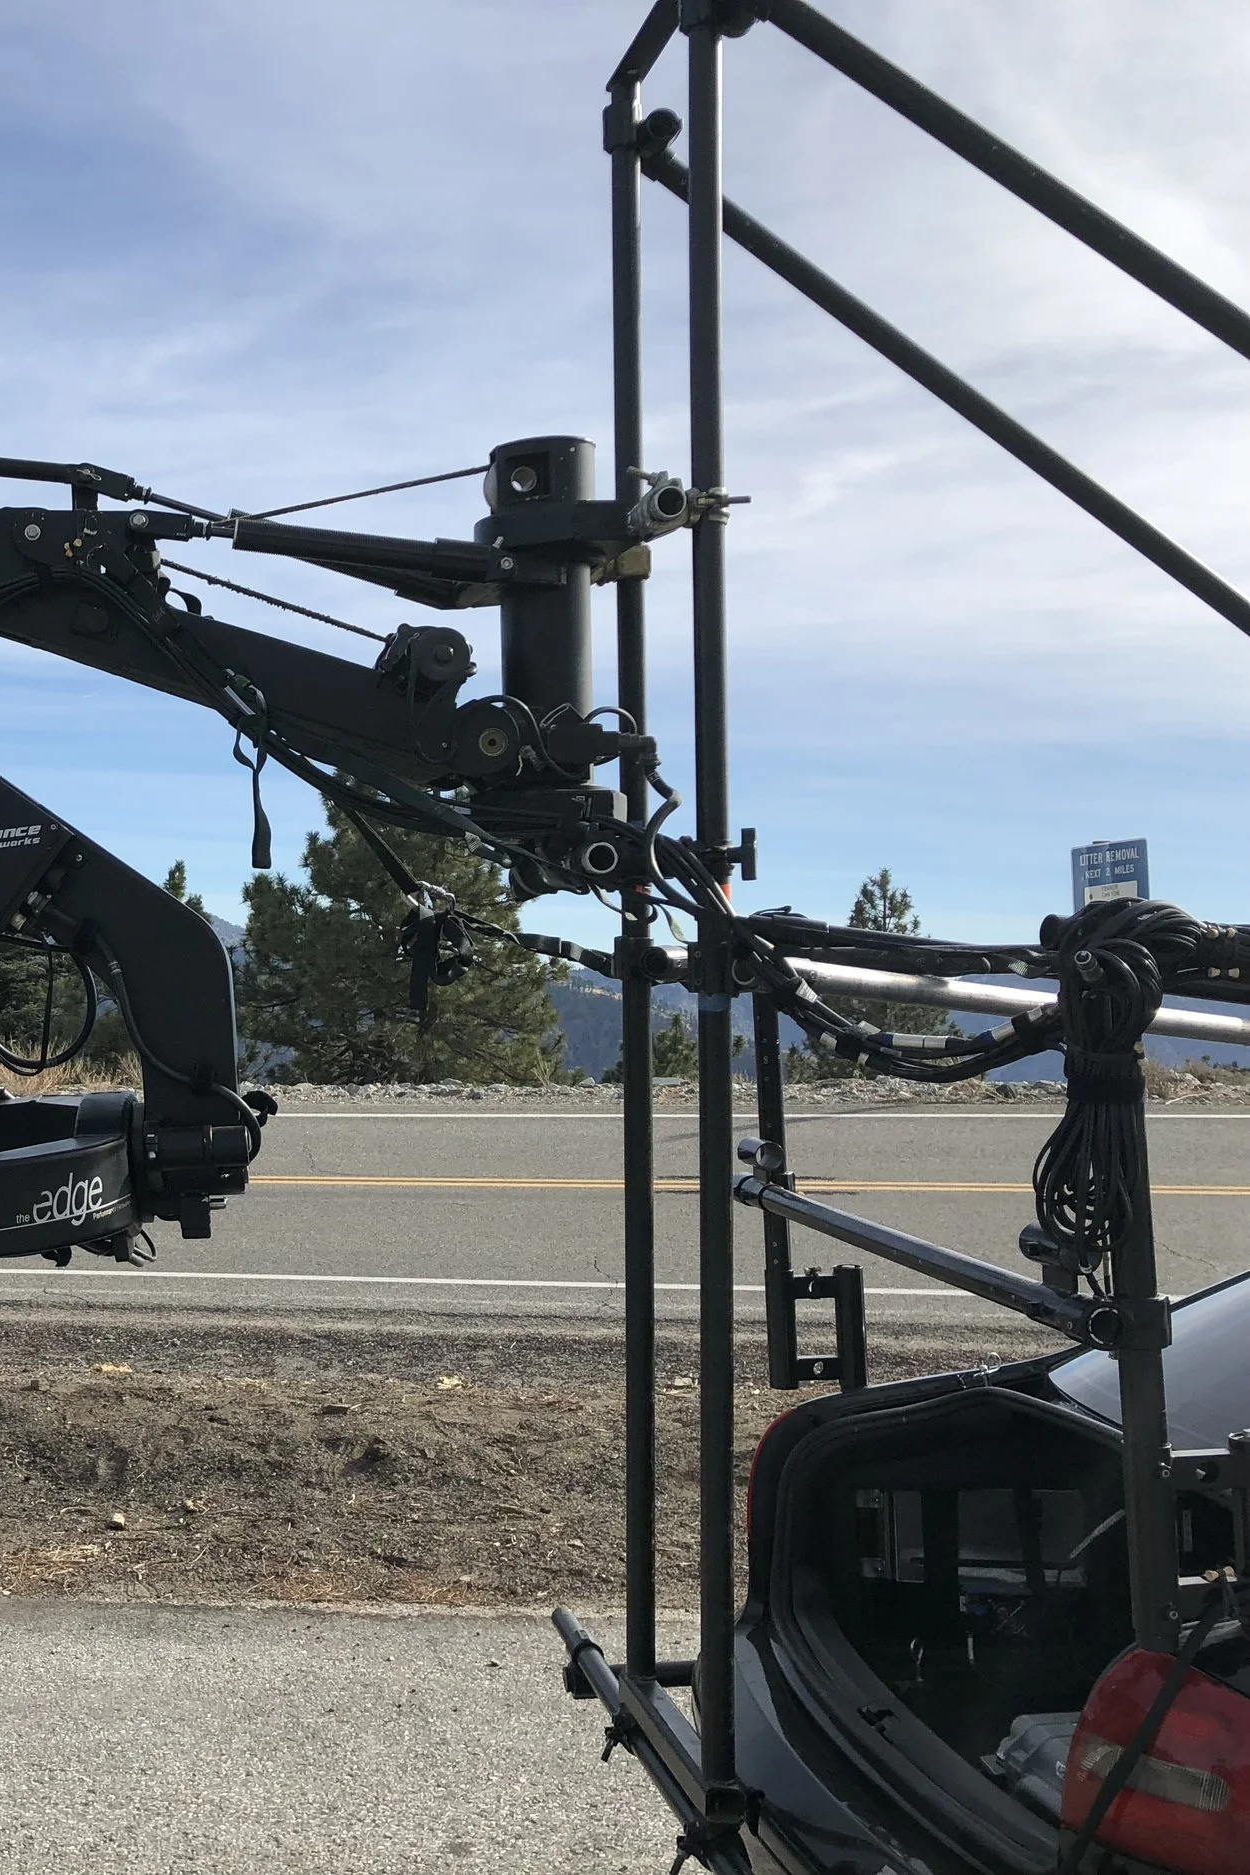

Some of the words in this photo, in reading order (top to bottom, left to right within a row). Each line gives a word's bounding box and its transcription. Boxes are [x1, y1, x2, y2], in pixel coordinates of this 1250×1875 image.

[1106, 848, 1139, 862] REMOVAL
[1086, 868, 1101, 878] NEXT
[1115, 864, 1134, 874] MILES
[15, 1212, 31, 1224] the
[33, 1172, 103, 1226] edge
